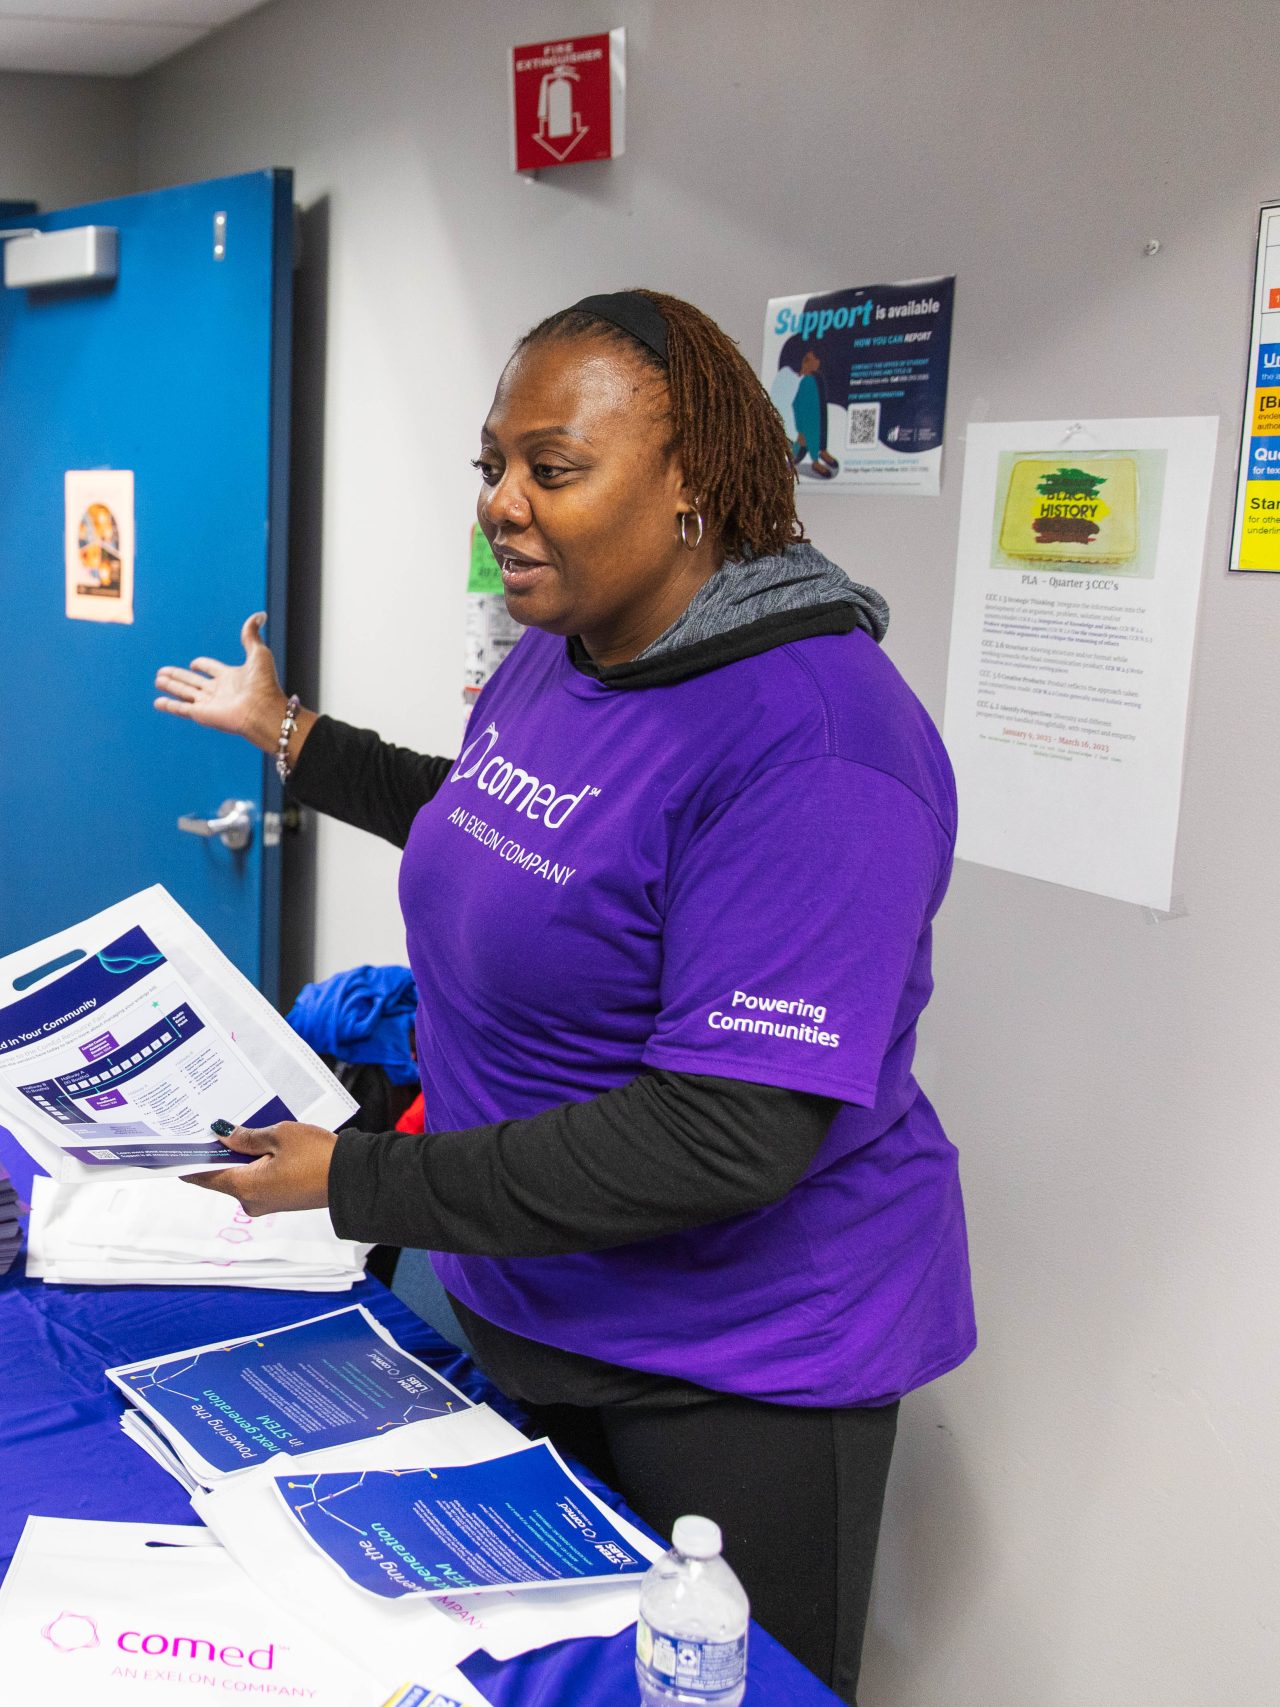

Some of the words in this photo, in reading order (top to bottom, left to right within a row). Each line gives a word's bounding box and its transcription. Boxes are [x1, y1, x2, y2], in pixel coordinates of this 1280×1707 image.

[774, 299, 874, 341] Support
[875, 305, 886, 320] is
[887, 297, 941, 318] available
[904, 331, 932, 343] REPORT
[1252, 465, 1265, 474] for
[1040, 503, 1098, 518] HISTORY
[1248, 515, 1261, 523] for
[1021, 575, 1038, 586] PLA
[1049, 576, 1084, 589] Quarter
[1002, 727, 1027, 740] January
[1057, 737, 1080, 747] March
[479, 756, 589, 829] comed
[448, 806, 468, 824] AN
[464, 814, 500, 851] EXELON
[500, 840, 576, 885] COMPANY
[731, 991, 827, 1022] Powering
[8, 1037, 19, 1047] in
[18, 1028, 42, 1043] Your
[42, 997, 97, 1031] Community
[707, 1011, 840, 1048] Communities
[60, 1072, 80, 1082] Hallway
[397, 1379, 419, 1394] STEM
[406, 1376, 429, 1392] LABS
[191, 1403, 212, 1420] the
[202, 1389, 260, 1434] generation
[256, 1414, 292, 1439] STEM
[207, 1418, 259, 1459] Powering
[251, 1433, 282, 1452] next
[288, 1437, 304, 1448] in
[558, 1503, 586, 1528] comed
[358, 1540, 384, 1561] the
[370, 1523, 441, 1582] generation
[594, 1544, 622, 1565] STEM
[604, 1543, 632, 1564] LABS
[437, 1595, 484, 1630] MPANY
[116, 1631, 274, 1671] comed
[111, 1665, 137, 1679] AN
[142, 1667, 216, 1687] EXELON
[220, 1679, 318, 1699] COMPANY
